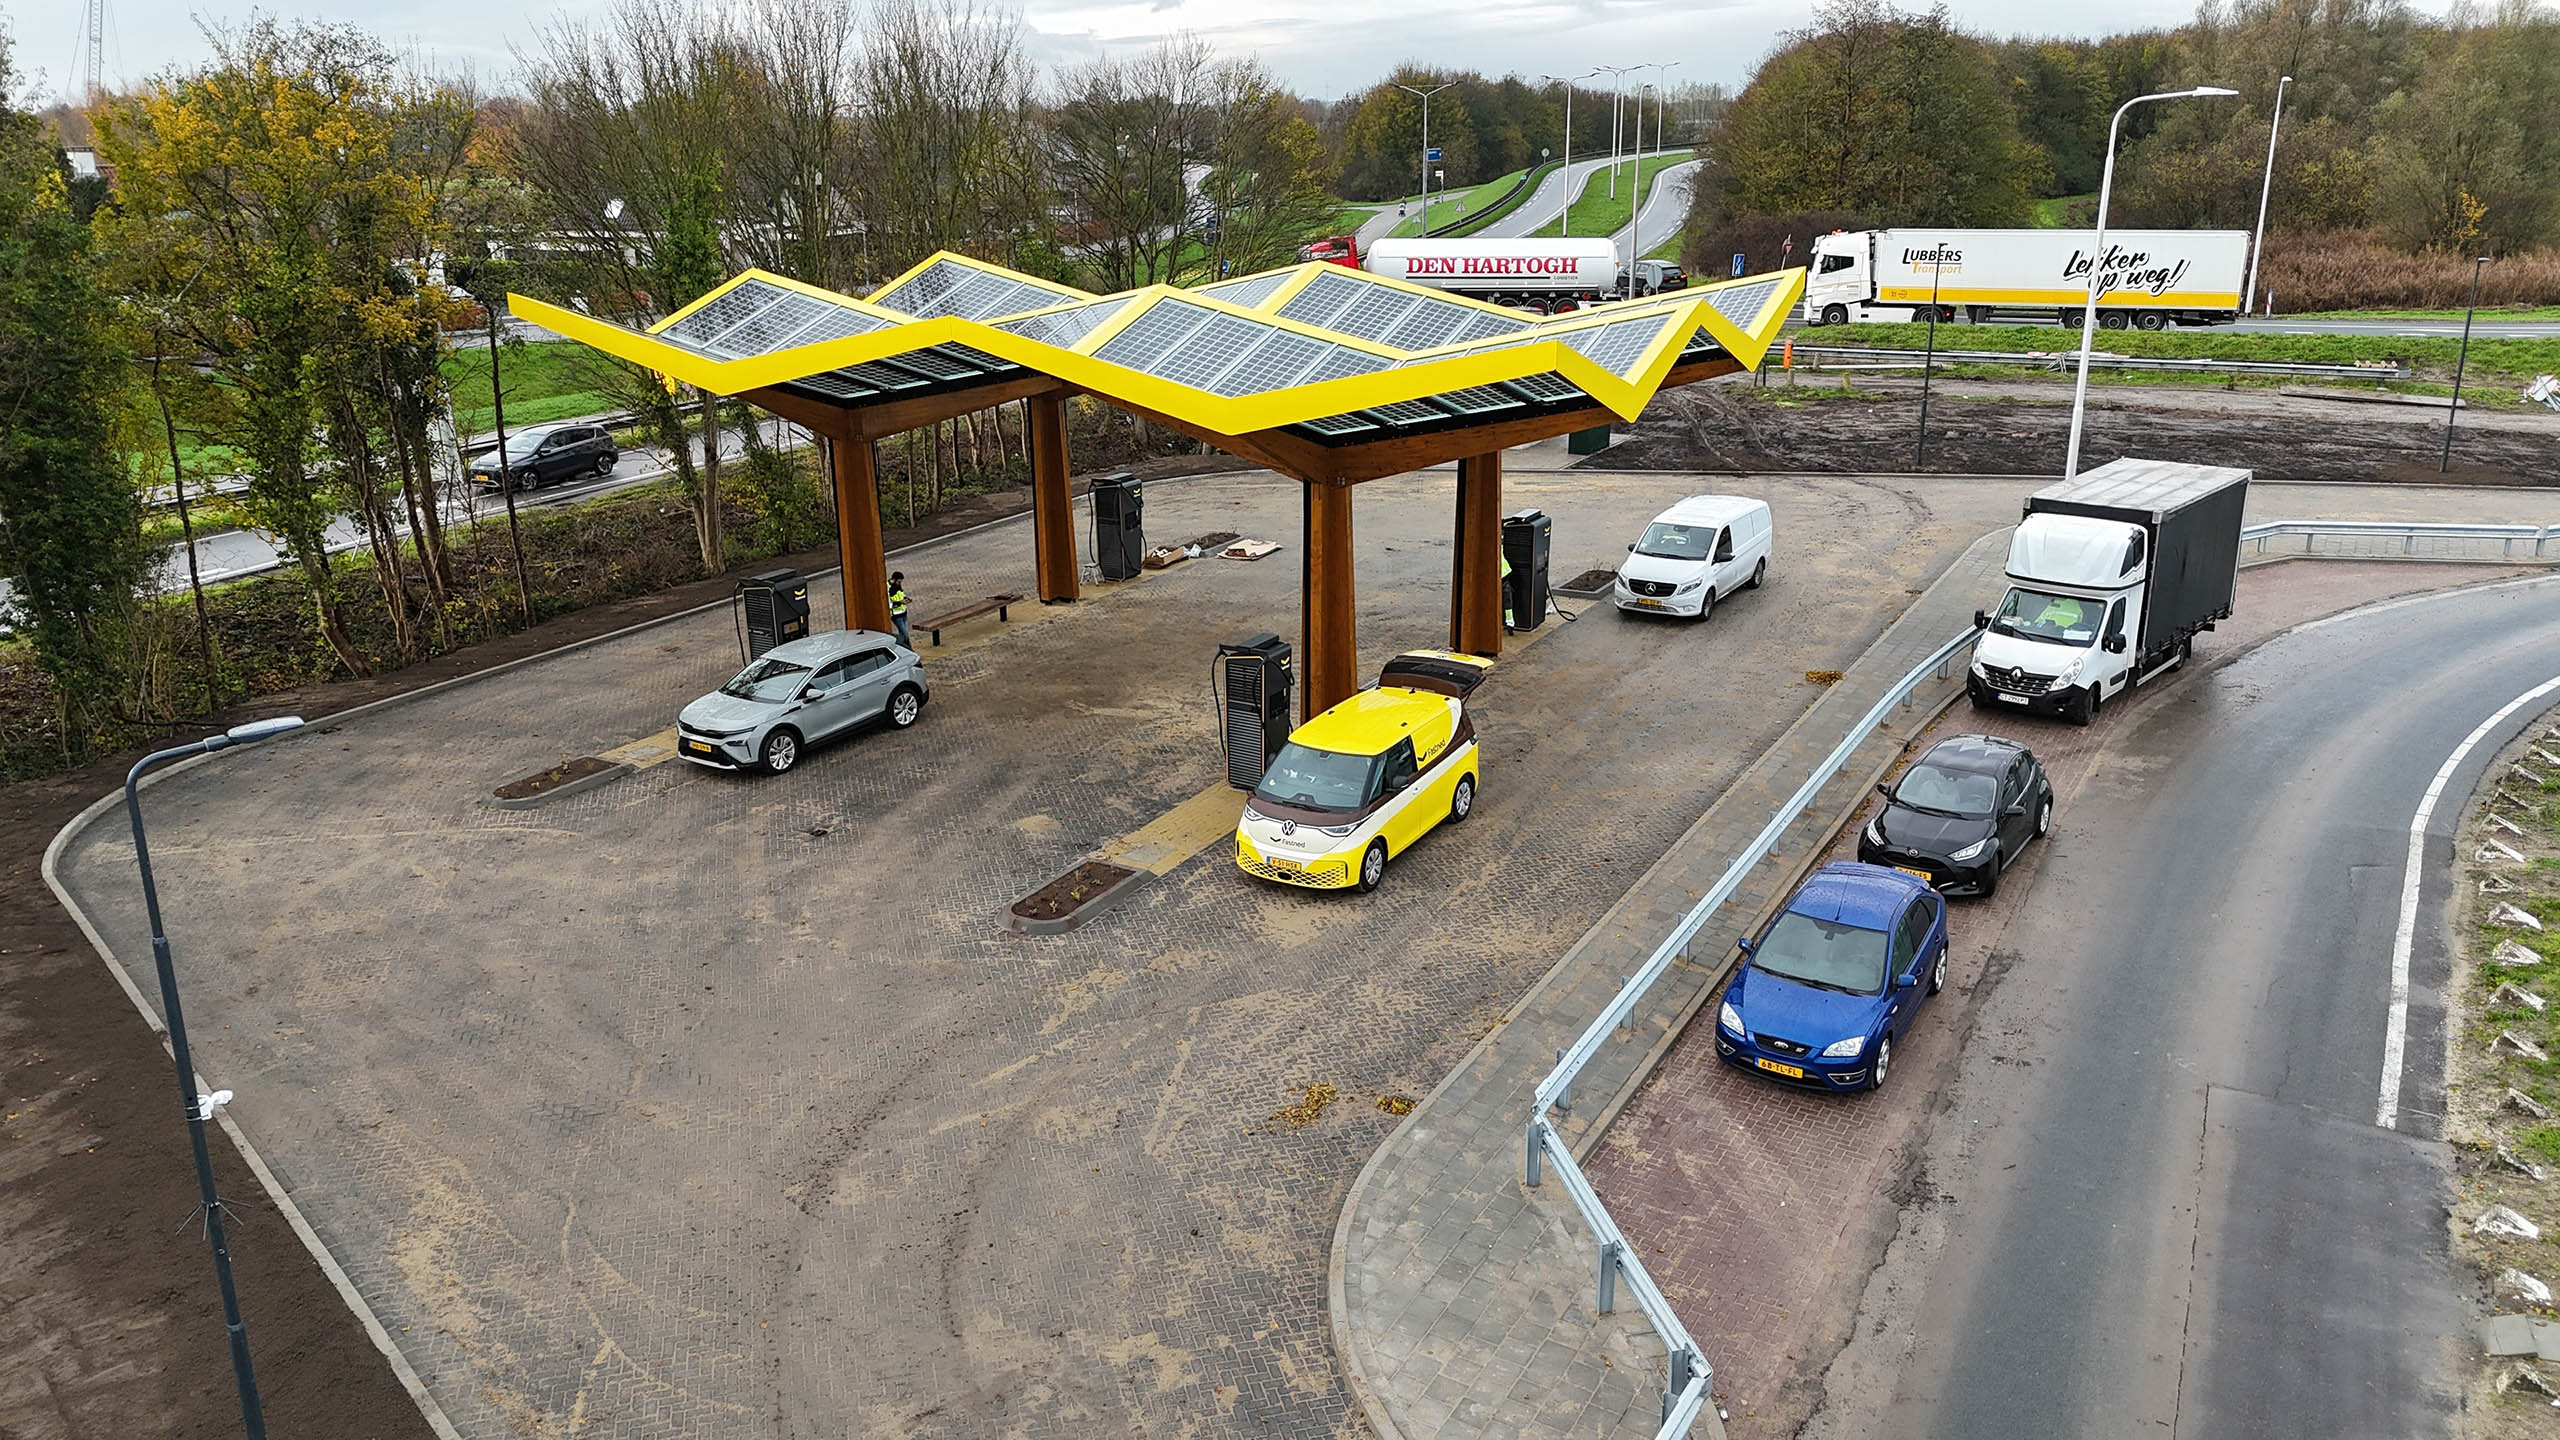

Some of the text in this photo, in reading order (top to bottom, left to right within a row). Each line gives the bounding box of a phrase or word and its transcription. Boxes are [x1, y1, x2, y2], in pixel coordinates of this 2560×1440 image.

[1902, 247, 1963, 264] LUBBERS
[1406, 257, 1578, 274] DEN HARTOGH
[1912, 261, 1963, 275] Tranport
[2126, 258, 2186, 294] weg!
